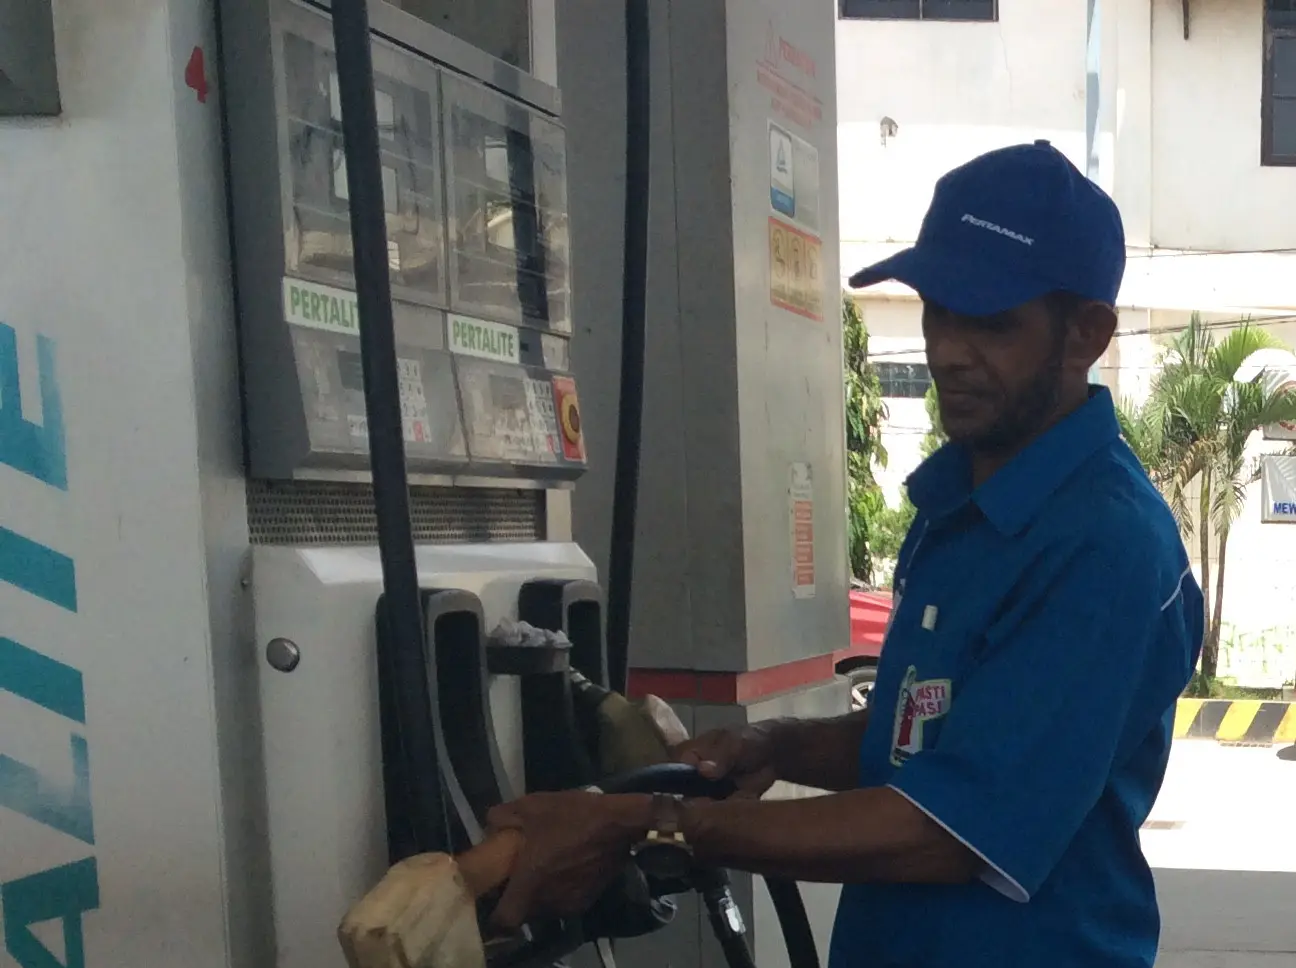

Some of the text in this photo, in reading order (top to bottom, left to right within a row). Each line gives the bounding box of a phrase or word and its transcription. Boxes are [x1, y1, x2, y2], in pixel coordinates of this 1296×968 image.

[961, 213, 1034, 245] PERTAMAX
[290, 285, 358, 329] PERTALI
[453, 320, 514, 357] PERTALITE
